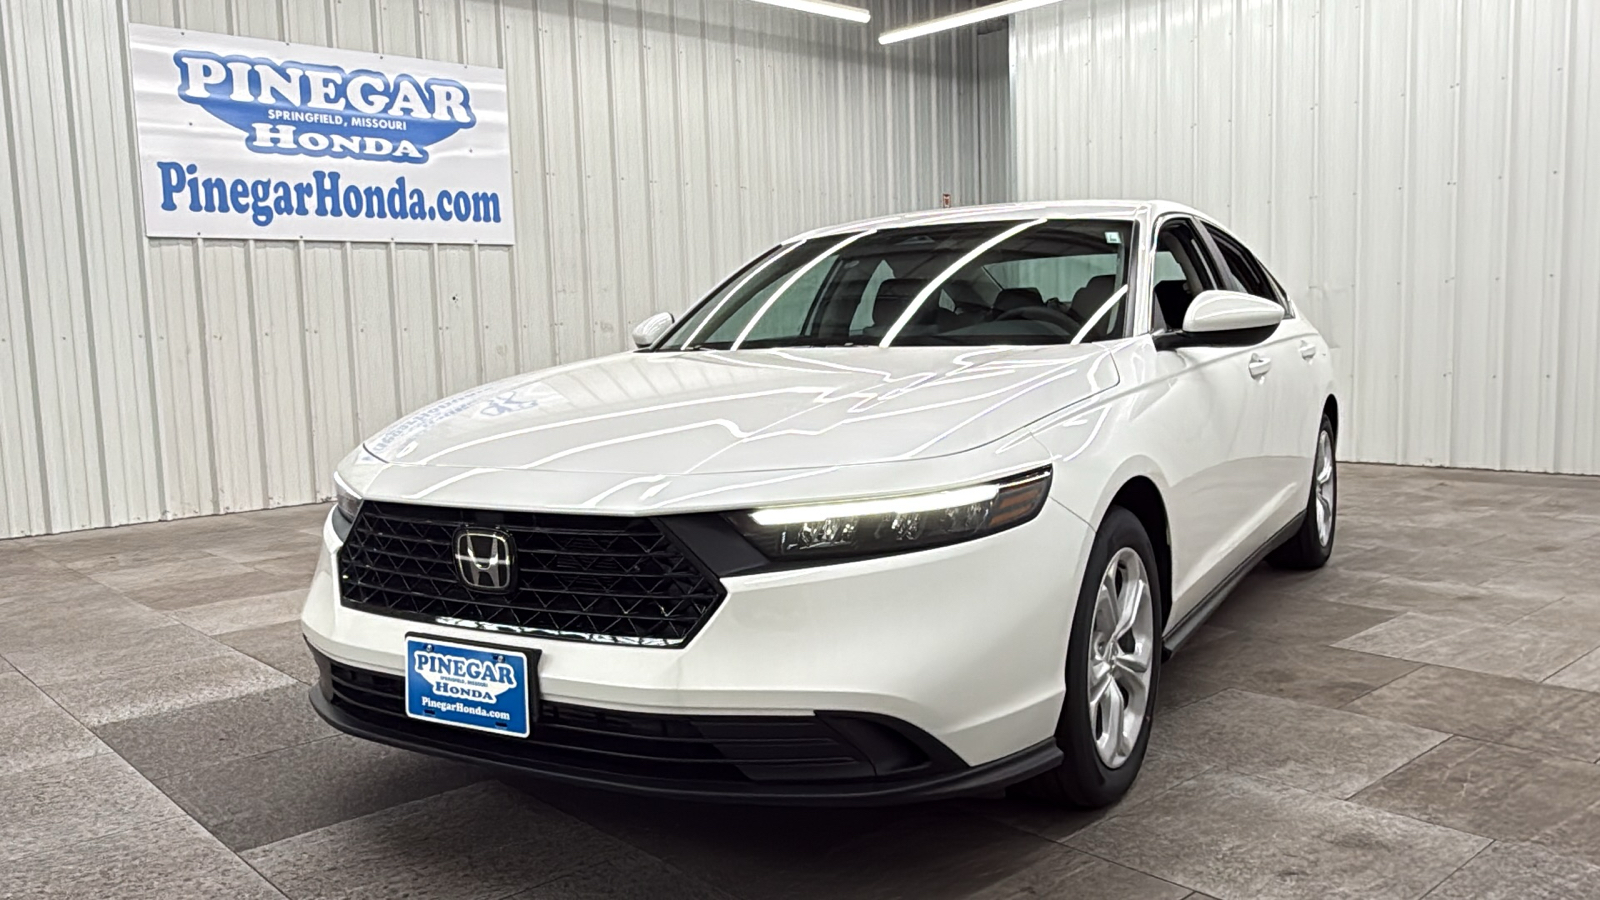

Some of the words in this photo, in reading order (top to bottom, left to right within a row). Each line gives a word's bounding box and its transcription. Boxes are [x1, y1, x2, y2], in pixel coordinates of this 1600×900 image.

[181, 56, 471, 123] PINEGAR
[268, 109, 348, 127] SPRINGFIELD,
[351, 117, 407, 131] MISSOURI
[251, 123, 424, 158] HONDA
[157, 161, 502, 226] PinegarHonda.com
[416, 654, 514, 685] PINEGAR
[435, 681, 493, 700] HONDA
[421, 696, 510, 720] PinegarHonda.com
